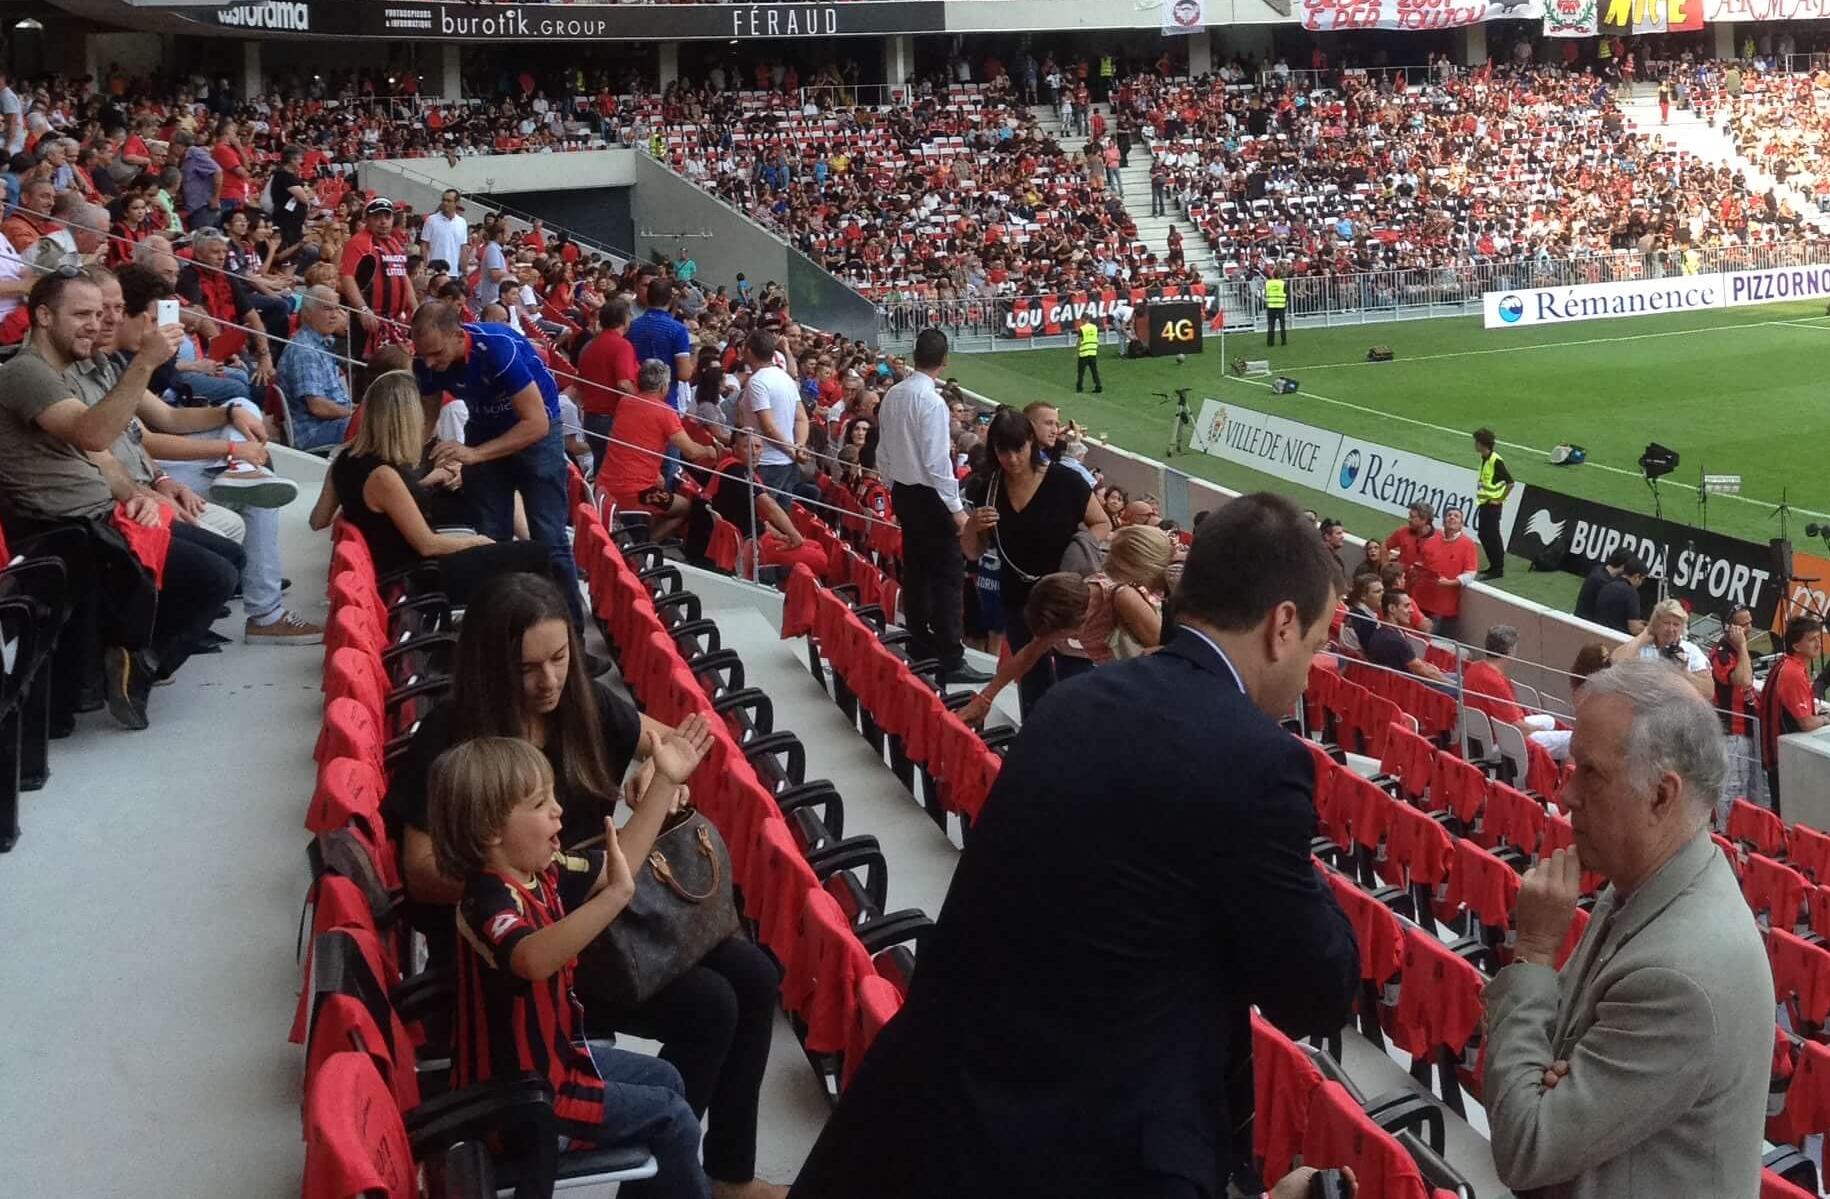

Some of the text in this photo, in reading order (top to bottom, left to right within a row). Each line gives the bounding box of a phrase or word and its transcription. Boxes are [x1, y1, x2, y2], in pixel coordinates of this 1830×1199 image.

[734, 5, 837, 36] FÉRAUD
[1007, 307, 1043, 329] LOU
[1535, 285, 1715, 321] Rémanence
[1160, 319, 1195, 342] 4G
[1224, 419, 1321, 473] VILLE DE NICE
[1673, 548, 1770, 609] SPORT
